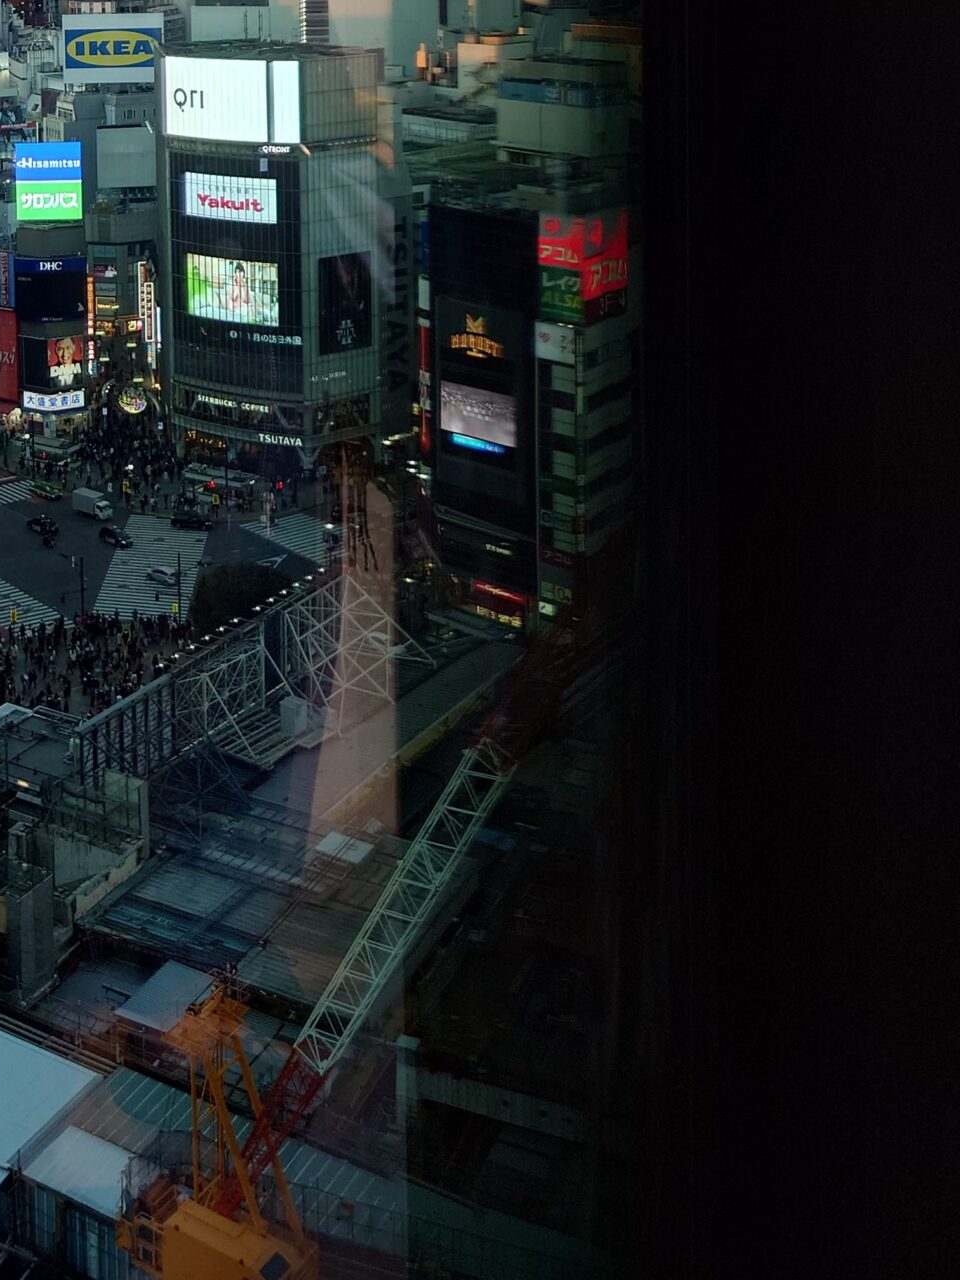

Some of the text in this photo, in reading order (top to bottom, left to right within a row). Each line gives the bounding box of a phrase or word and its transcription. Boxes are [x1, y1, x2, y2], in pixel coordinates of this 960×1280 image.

[75, 40, 155, 57] IKEA
[16, 157, 81, 169] Hisamitsu
[21, 192, 79, 209] サロンパス
[197, 193, 265, 213] Yakult
[539, 244, 580, 265] アコム
[40, 261, 63, 271] DHC
[542, 272, 581, 291] レイク
[50, 362, 82, 378] DMM
[27, 393, 81, 408] 大盛堂書店
[197, 394, 270, 414] STARBUCKS COFFEE
[258, 433, 303, 447] TSUTAYA
